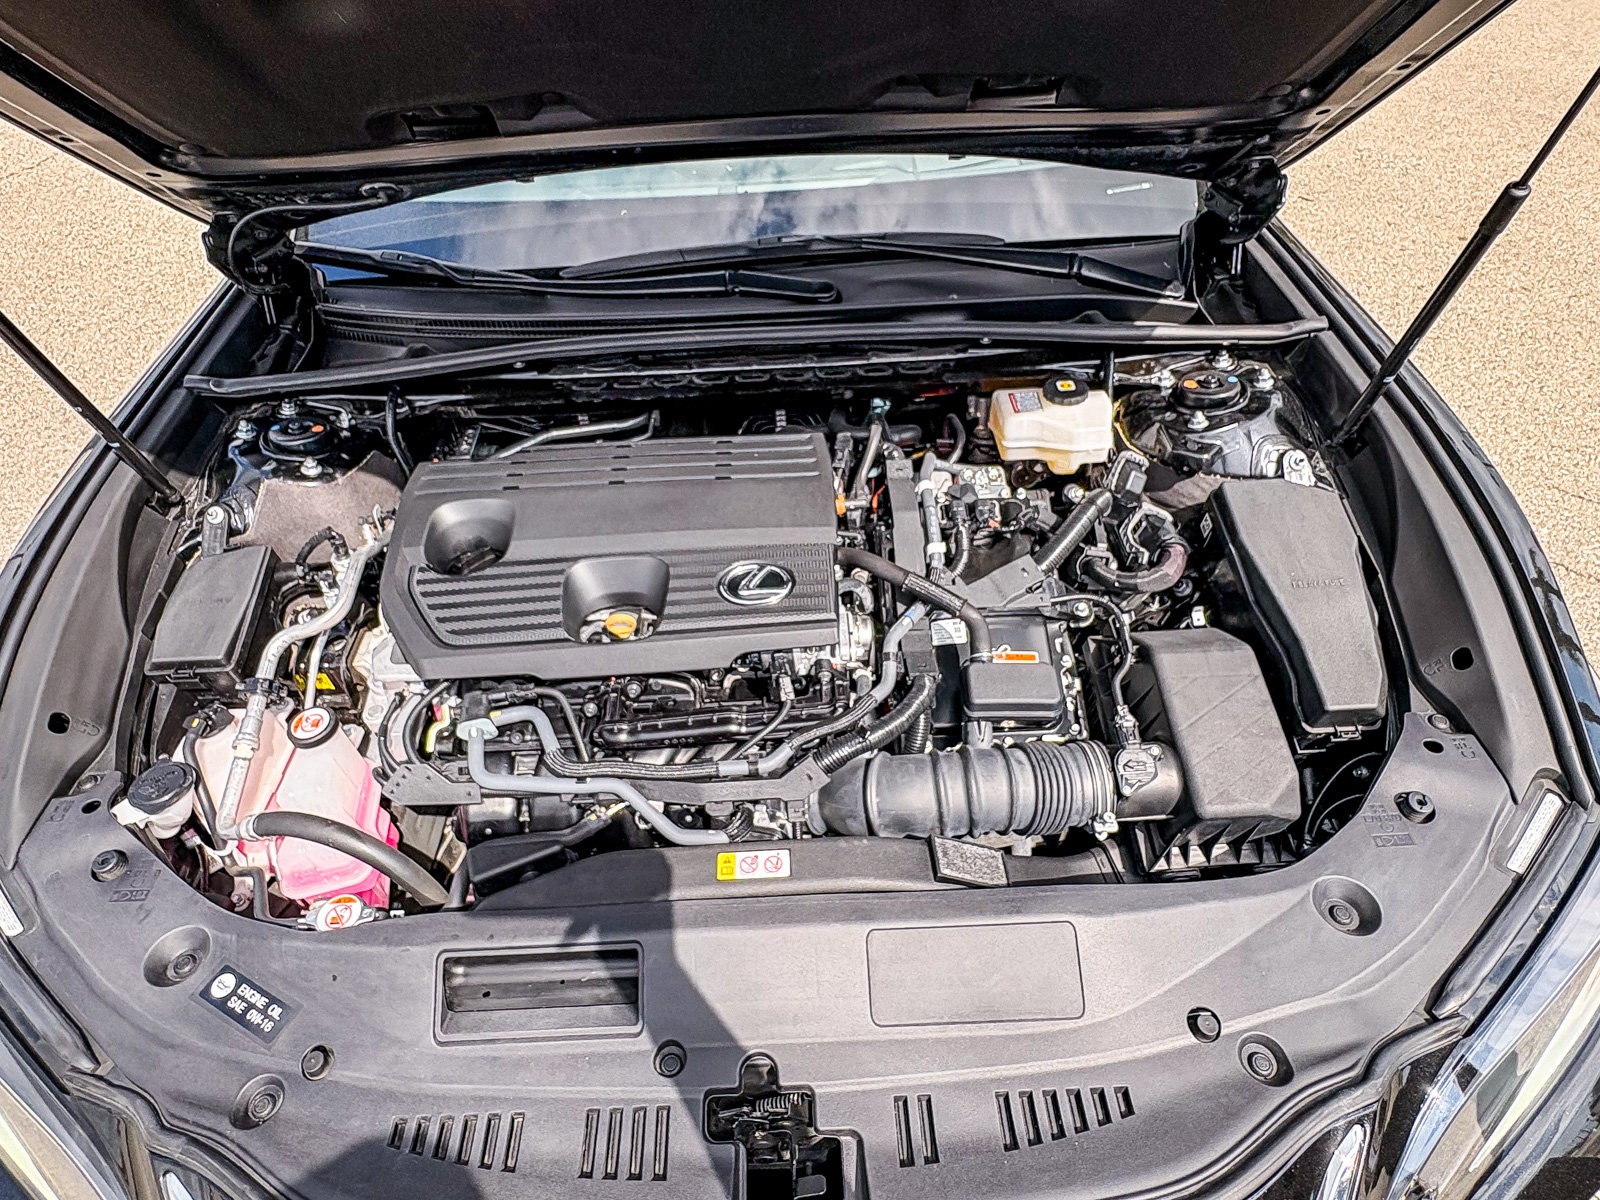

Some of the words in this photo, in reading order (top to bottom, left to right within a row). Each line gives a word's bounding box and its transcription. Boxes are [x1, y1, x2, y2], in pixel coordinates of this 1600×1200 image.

[227, 996, 248, 1014] SAE
[246, 1009, 274, 1032] 0W-16
[237, 983, 269, 1009] ENGINE
[267, 1004, 283, 1021] OIL
